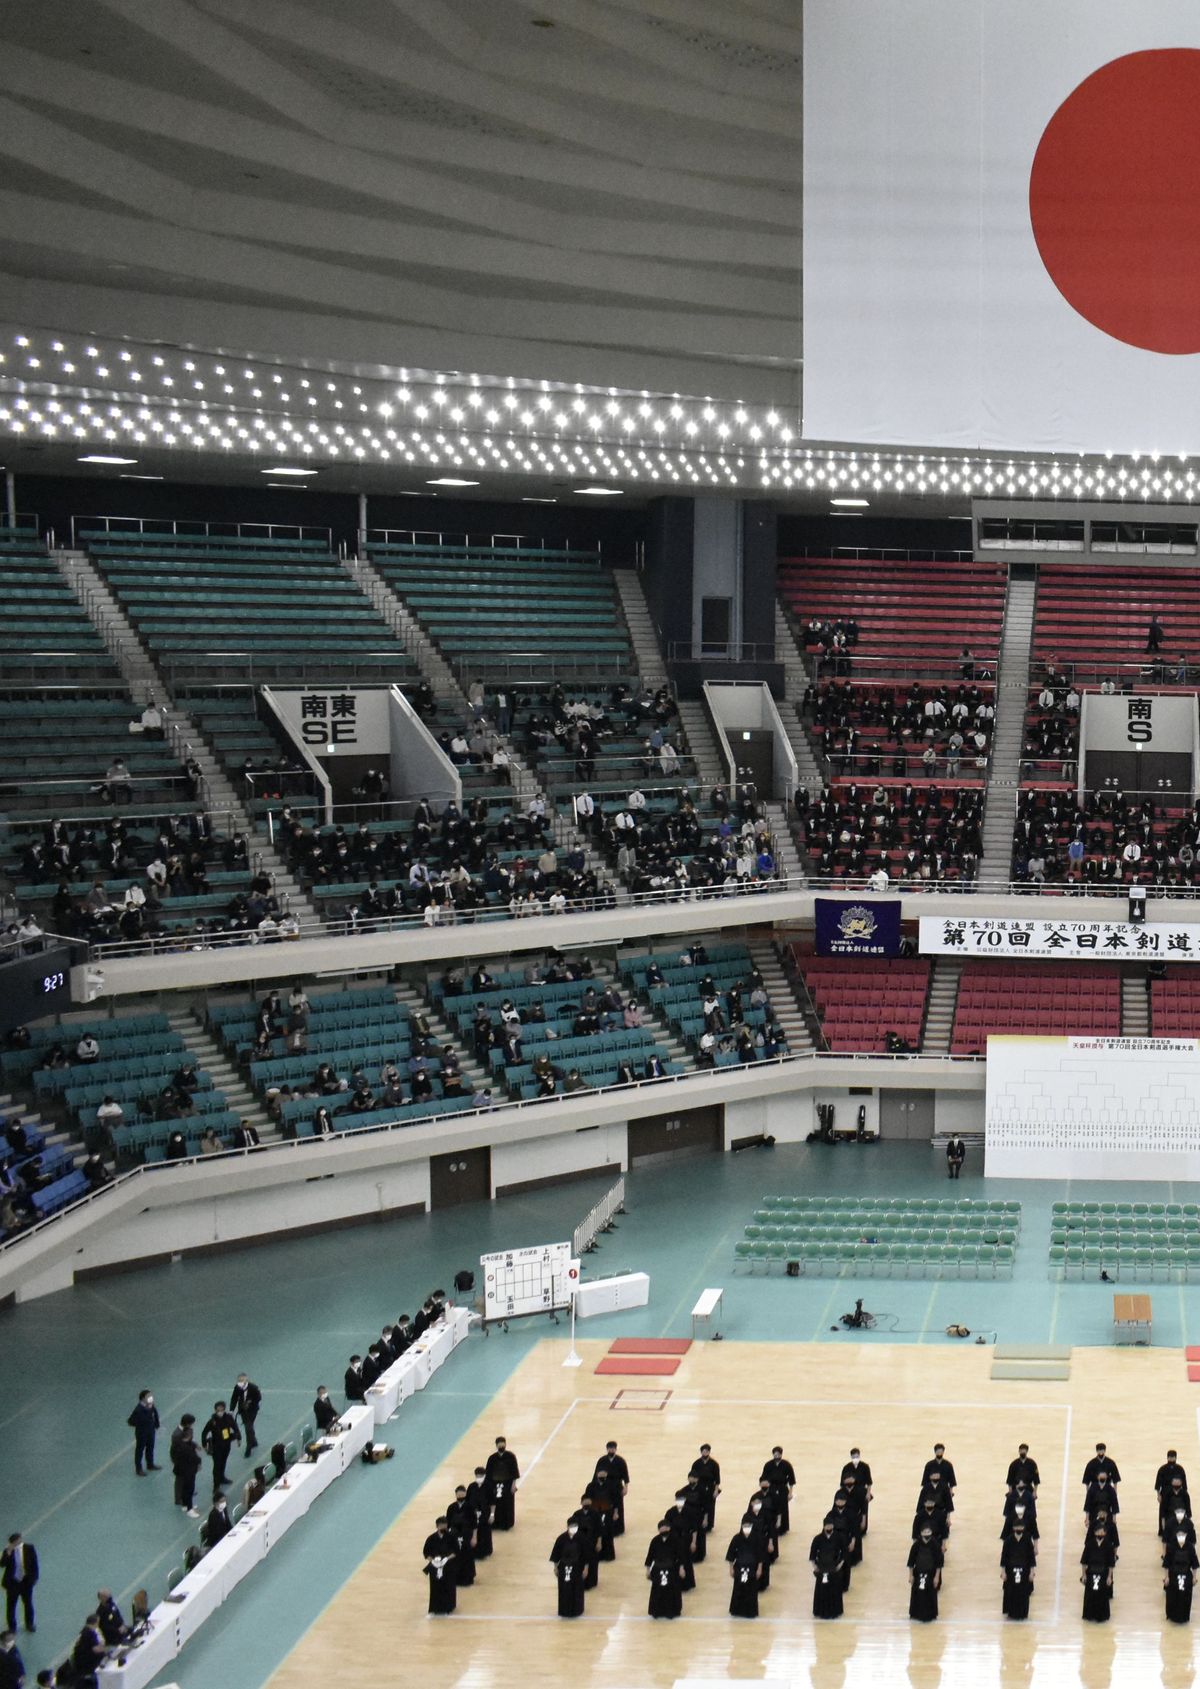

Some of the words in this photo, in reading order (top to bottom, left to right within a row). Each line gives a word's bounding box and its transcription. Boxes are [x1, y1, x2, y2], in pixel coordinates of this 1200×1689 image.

[301, 694, 357, 718] 南東
[1128, 698, 1152, 719] 南
[302, 720, 357, 744] SE
[1128, 721, 1152, 742] S
[942, 929, 1030, 946] 第70回
